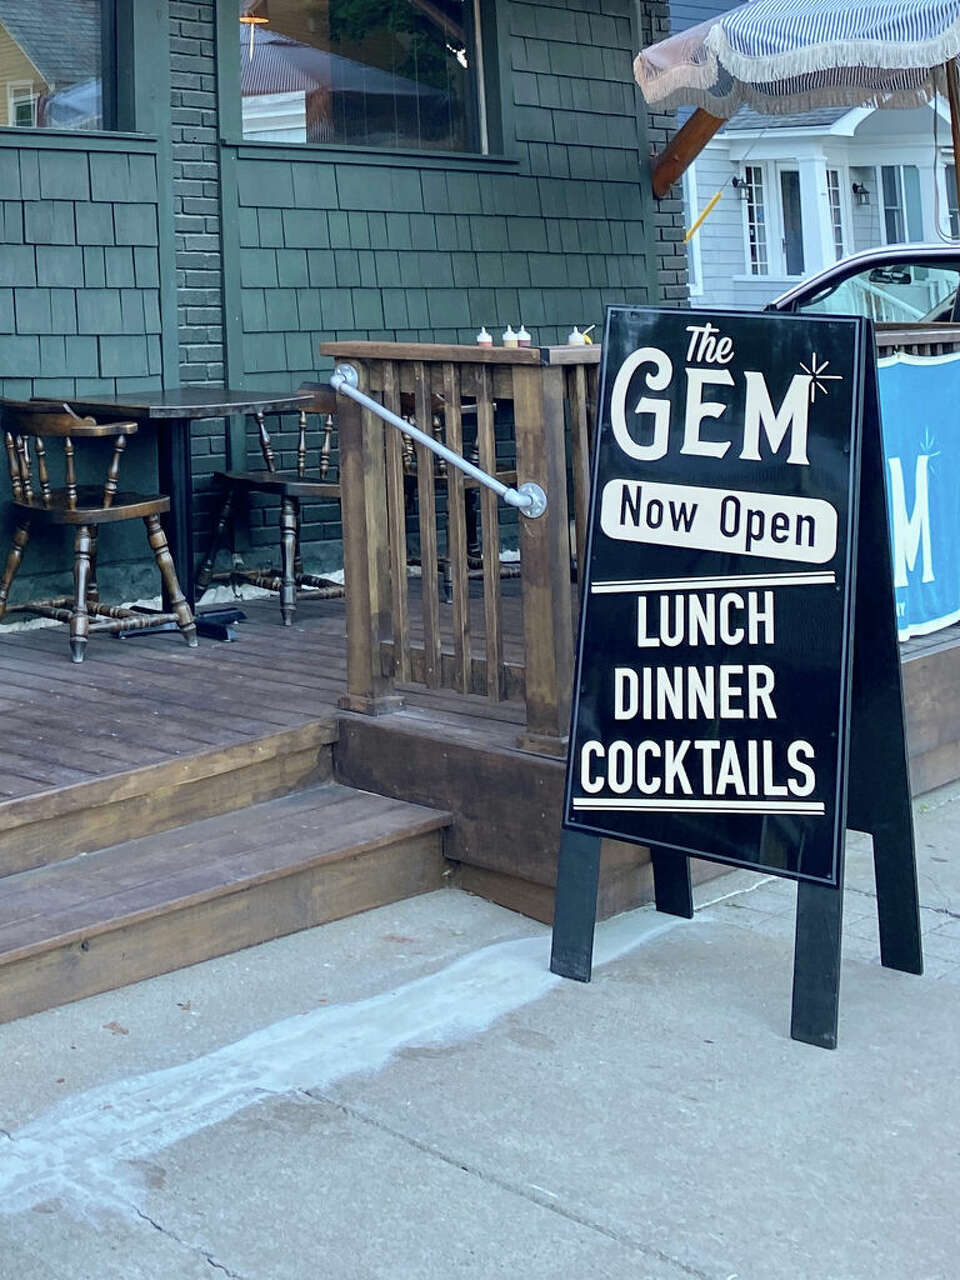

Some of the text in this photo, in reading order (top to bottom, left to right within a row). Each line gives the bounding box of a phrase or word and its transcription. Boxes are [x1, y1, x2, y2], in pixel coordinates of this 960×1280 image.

[686, 323, 734, 363] The
[611, 346, 810, 465] GEM
[620, 485, 816, 552] Now Open
[637, 591, 775, 647] LUNCH
[614, 665, 776, 719] DINNER
[581, 740, 815, 796] COCKTAILS
